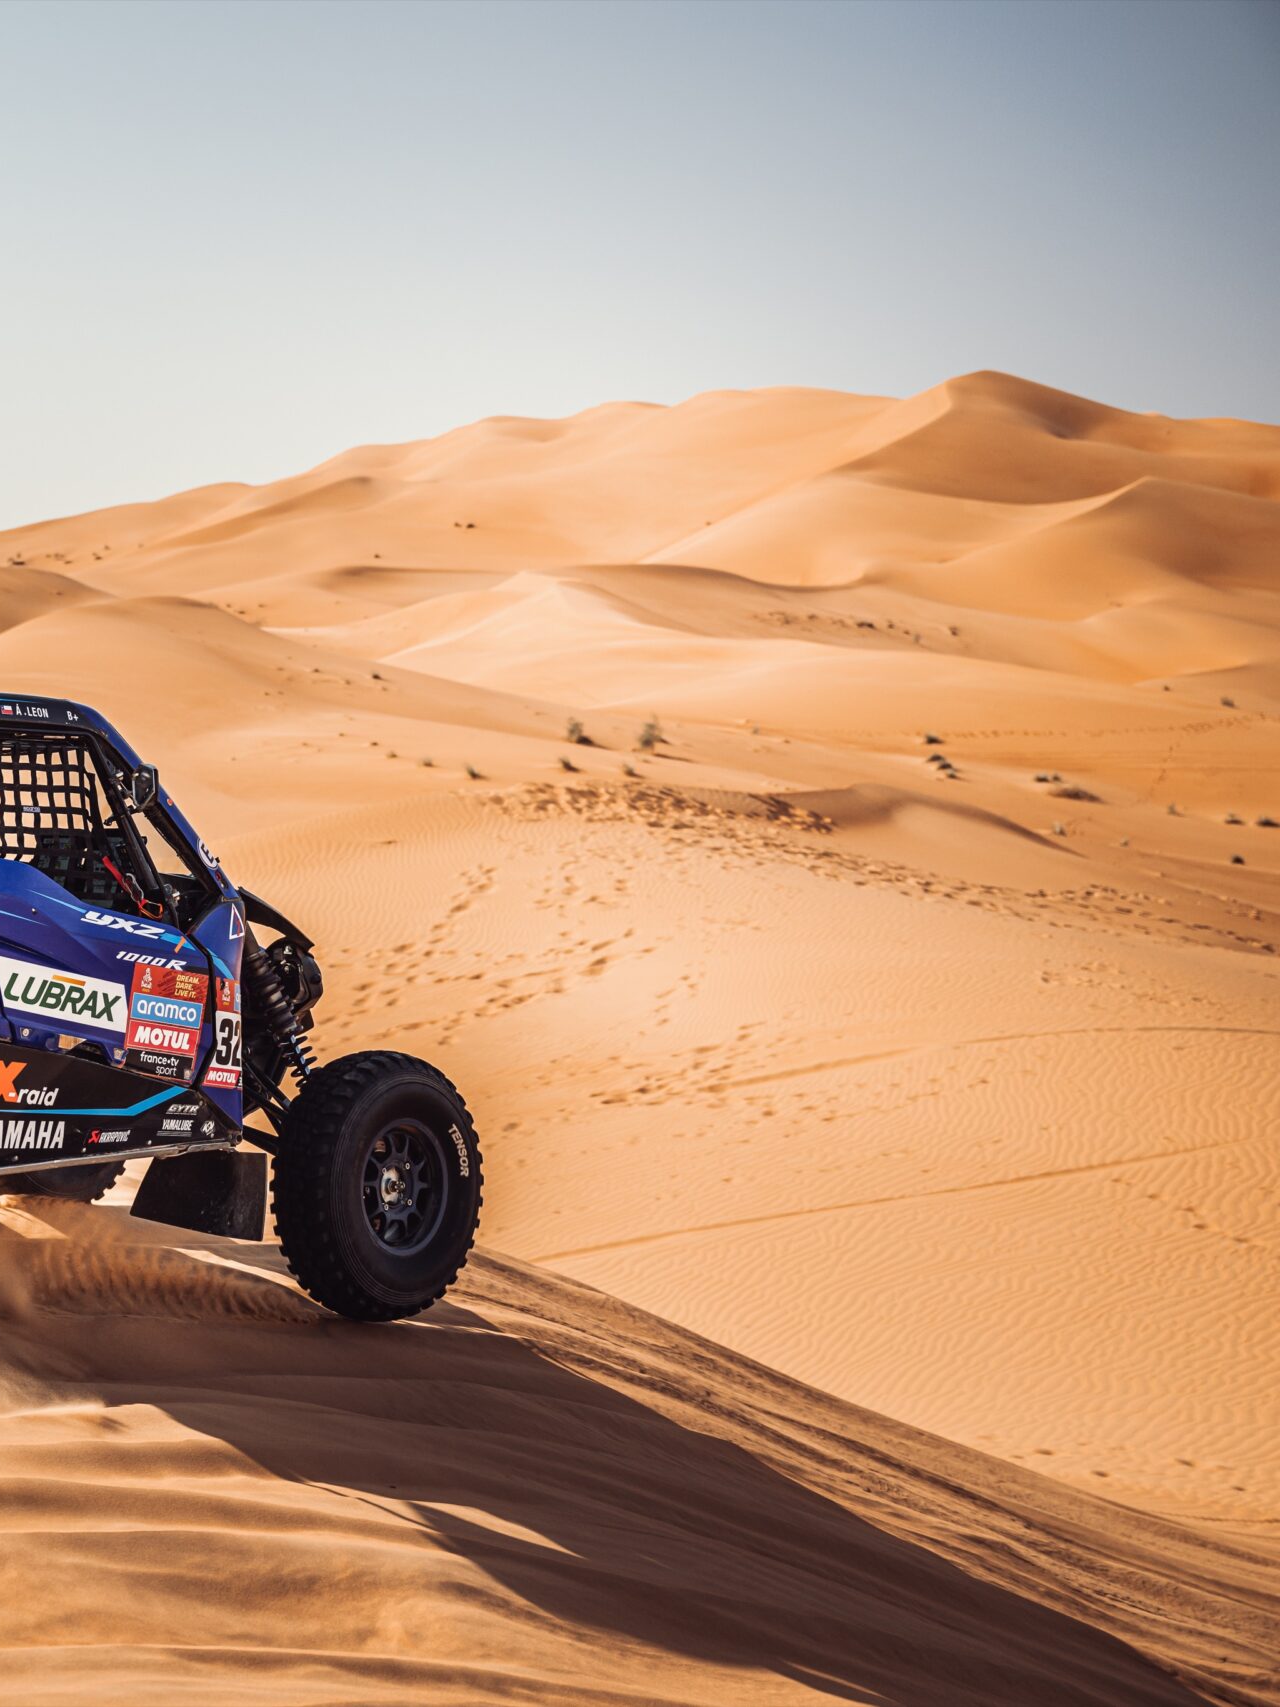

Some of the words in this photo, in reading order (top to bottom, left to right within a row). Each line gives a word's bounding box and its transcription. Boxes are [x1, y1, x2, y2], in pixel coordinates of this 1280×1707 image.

[176, 974, 200, 985] DREAM.
[175, 981, 194, 991] DARE.
[3, 972, 122, 1022] LUBRAX
[174, 989, 189, 997] LIVE
[137, 1000, 197, 1021] aramco
[134, 1026, 190, 1050] MOTUL
[155, 1066, 178, 1077] sport
[207, 1071, 236, 1084] MOTUL
[168, 1104, 199, 1113] GYTR
[162, 1119, 194, 1131] YAMALUBE
[448, 1123, 469, 1177] TENSOR
